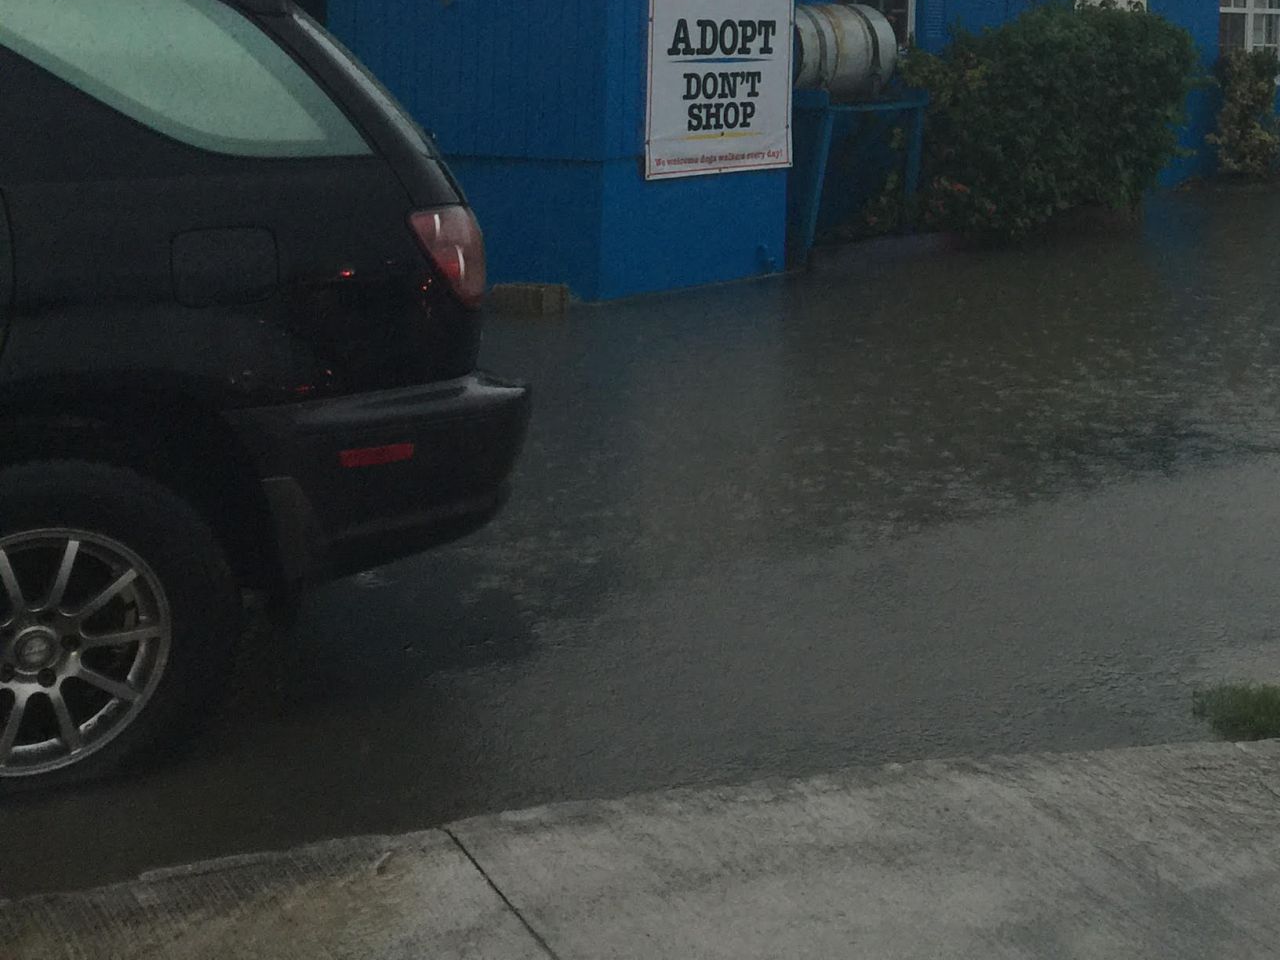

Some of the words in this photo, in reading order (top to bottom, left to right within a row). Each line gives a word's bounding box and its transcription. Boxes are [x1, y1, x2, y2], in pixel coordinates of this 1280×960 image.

[667, 18, 776, 56] ADOPT
[682, 71, 761, 100] DON'T
[688, 102, 755, 132] SHOP
